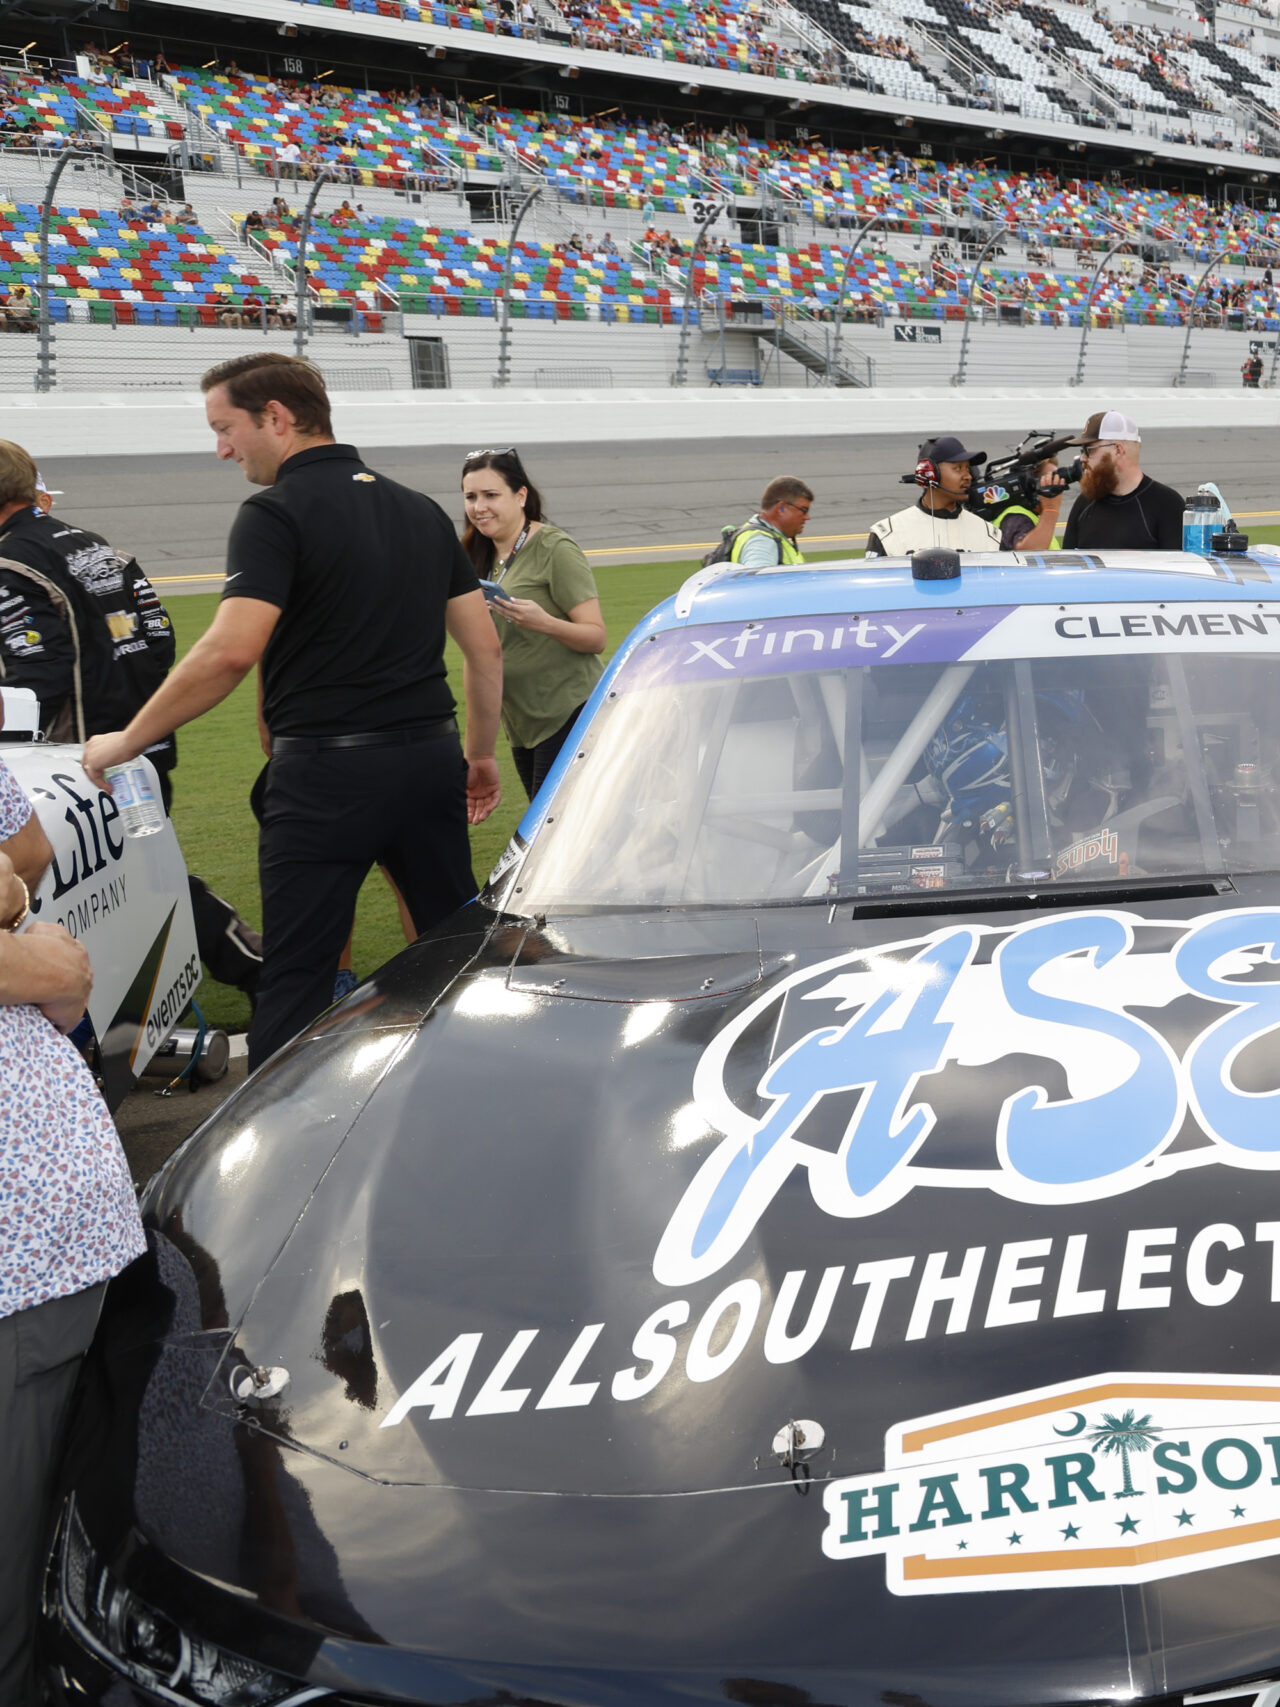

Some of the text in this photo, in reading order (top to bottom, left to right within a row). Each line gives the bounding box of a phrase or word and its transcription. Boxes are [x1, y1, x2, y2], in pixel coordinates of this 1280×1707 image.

[283, 57, 303, 73] 158
[555, 95, 569, 110] 157
[683, 619, 926, 670] xfinity
